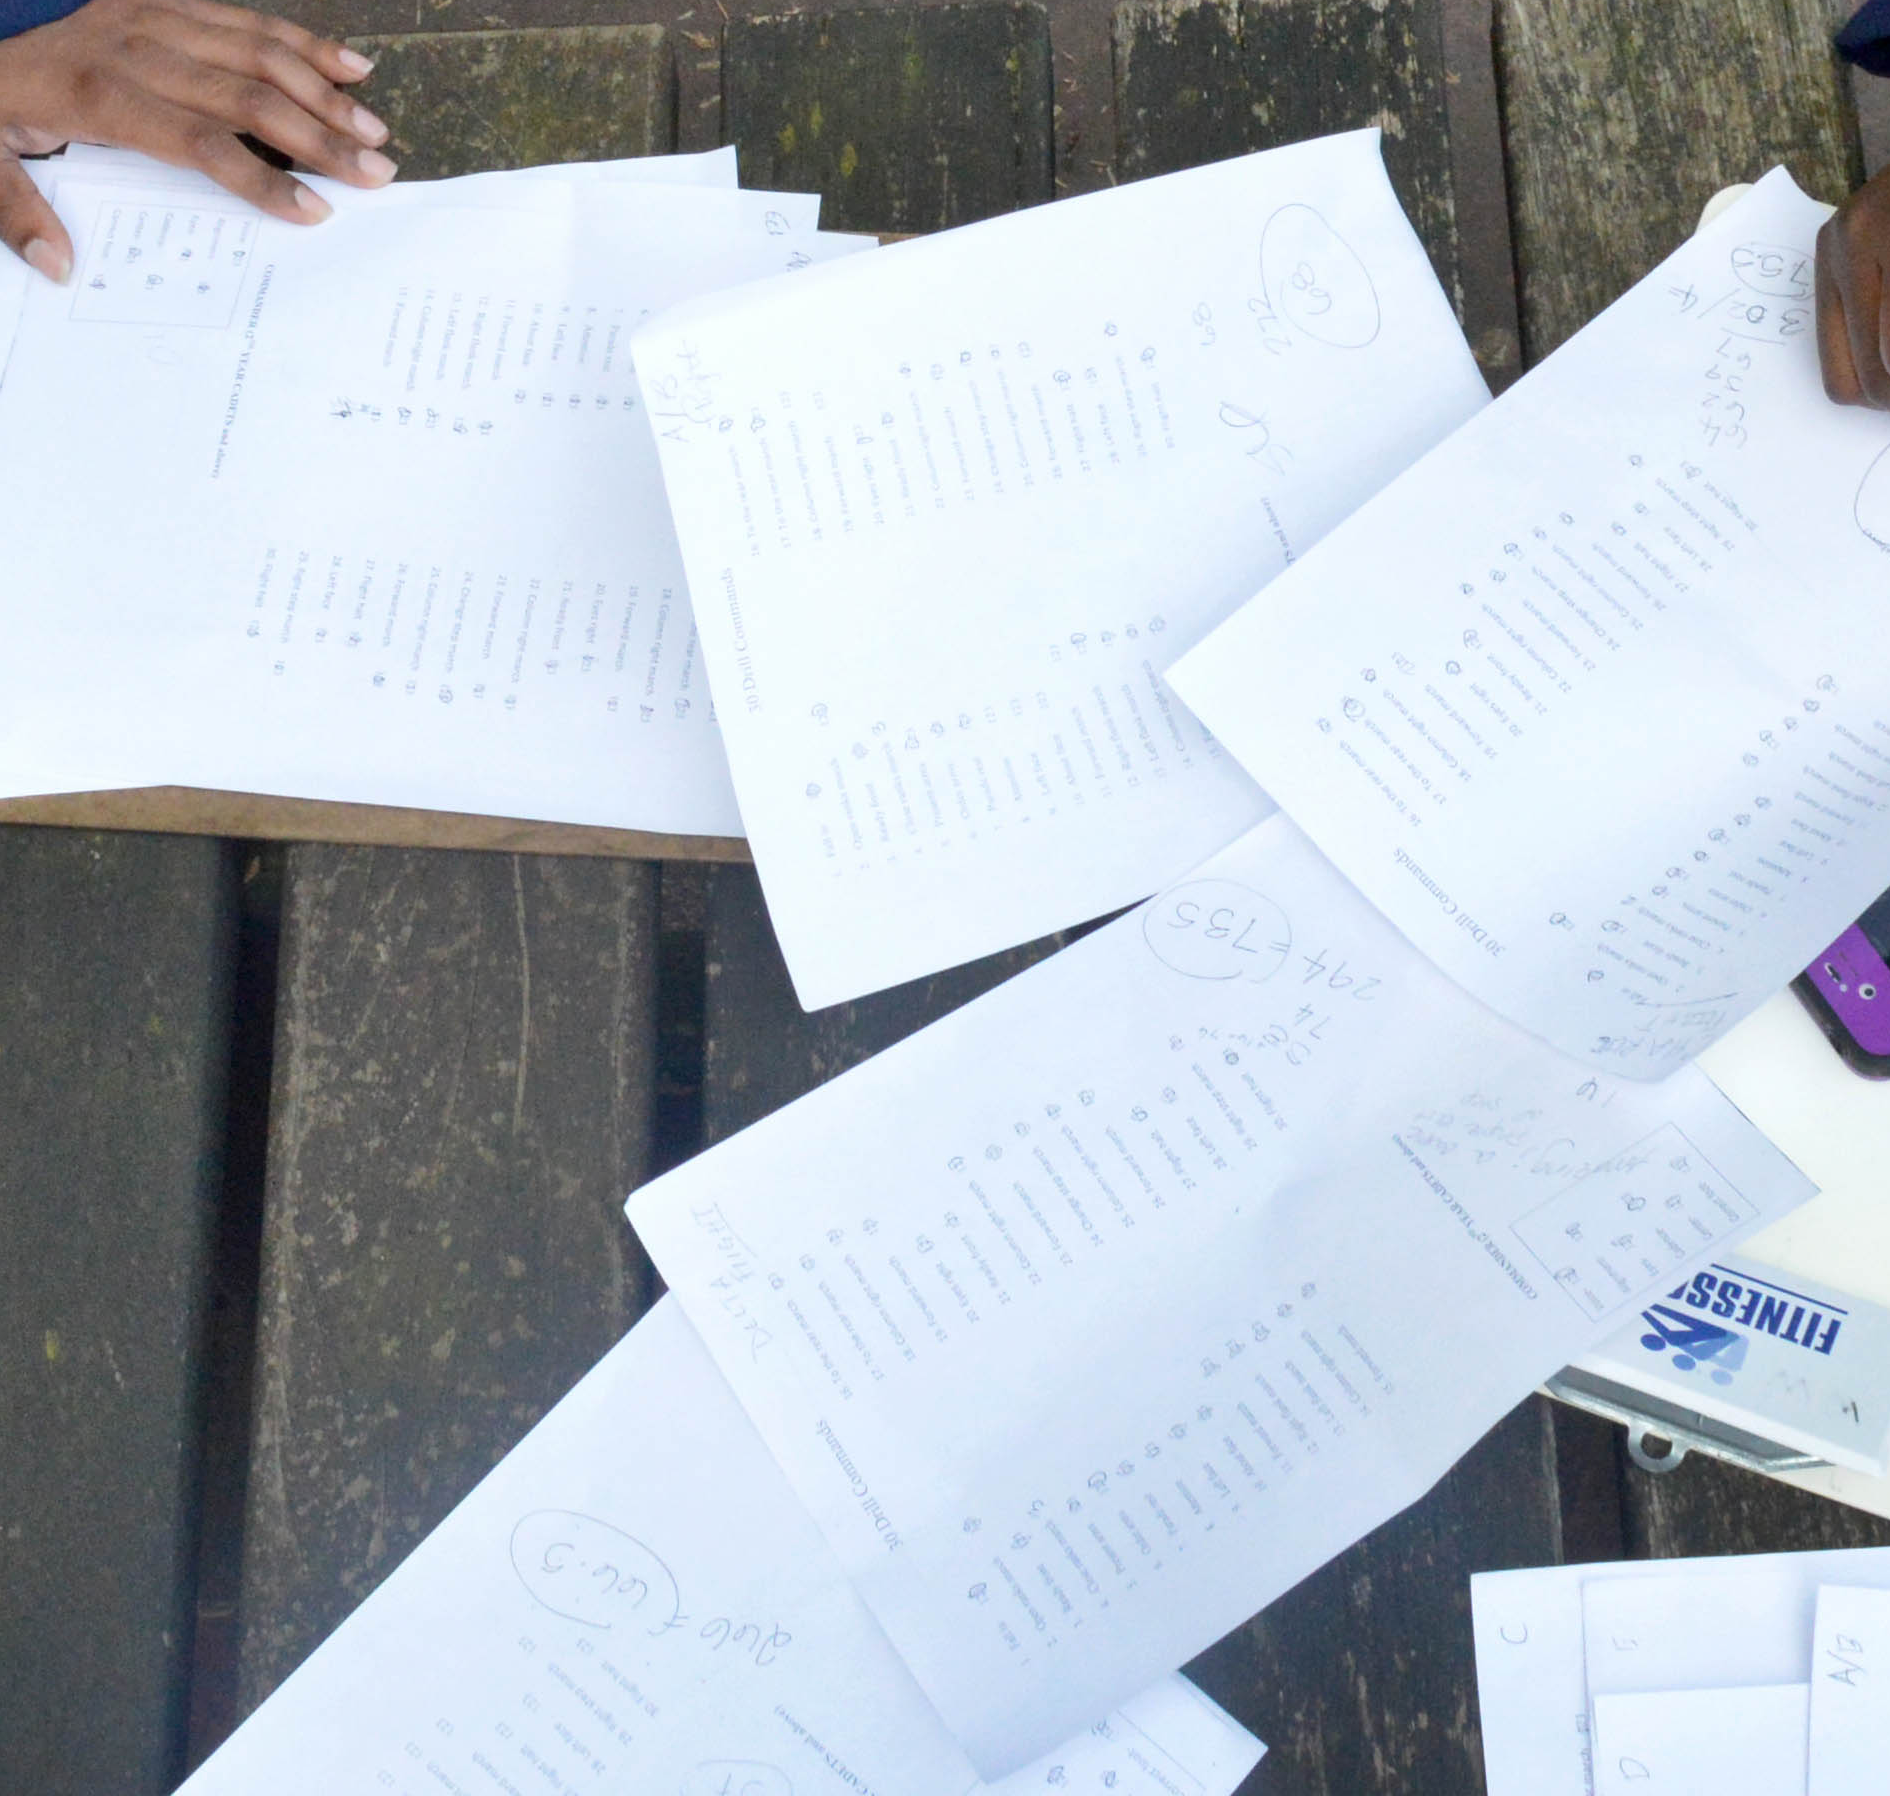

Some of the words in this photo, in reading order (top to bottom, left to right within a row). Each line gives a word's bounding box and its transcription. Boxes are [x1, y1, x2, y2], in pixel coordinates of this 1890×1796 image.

[721, 568, 749, 654] Commands
[1394, 848, 1460, 917] Commands
[1455, 913, 1489, 945] Drill
[1421, 1170, 1456, 1206] CADETS
[1450, 1201, 1476, 1230] YEAR
[1489, 1244, 1539, 1301] COMMANDER
[816, 1420, 870, 1499] Commands
[861, 1497, 893, 1534] Drill
